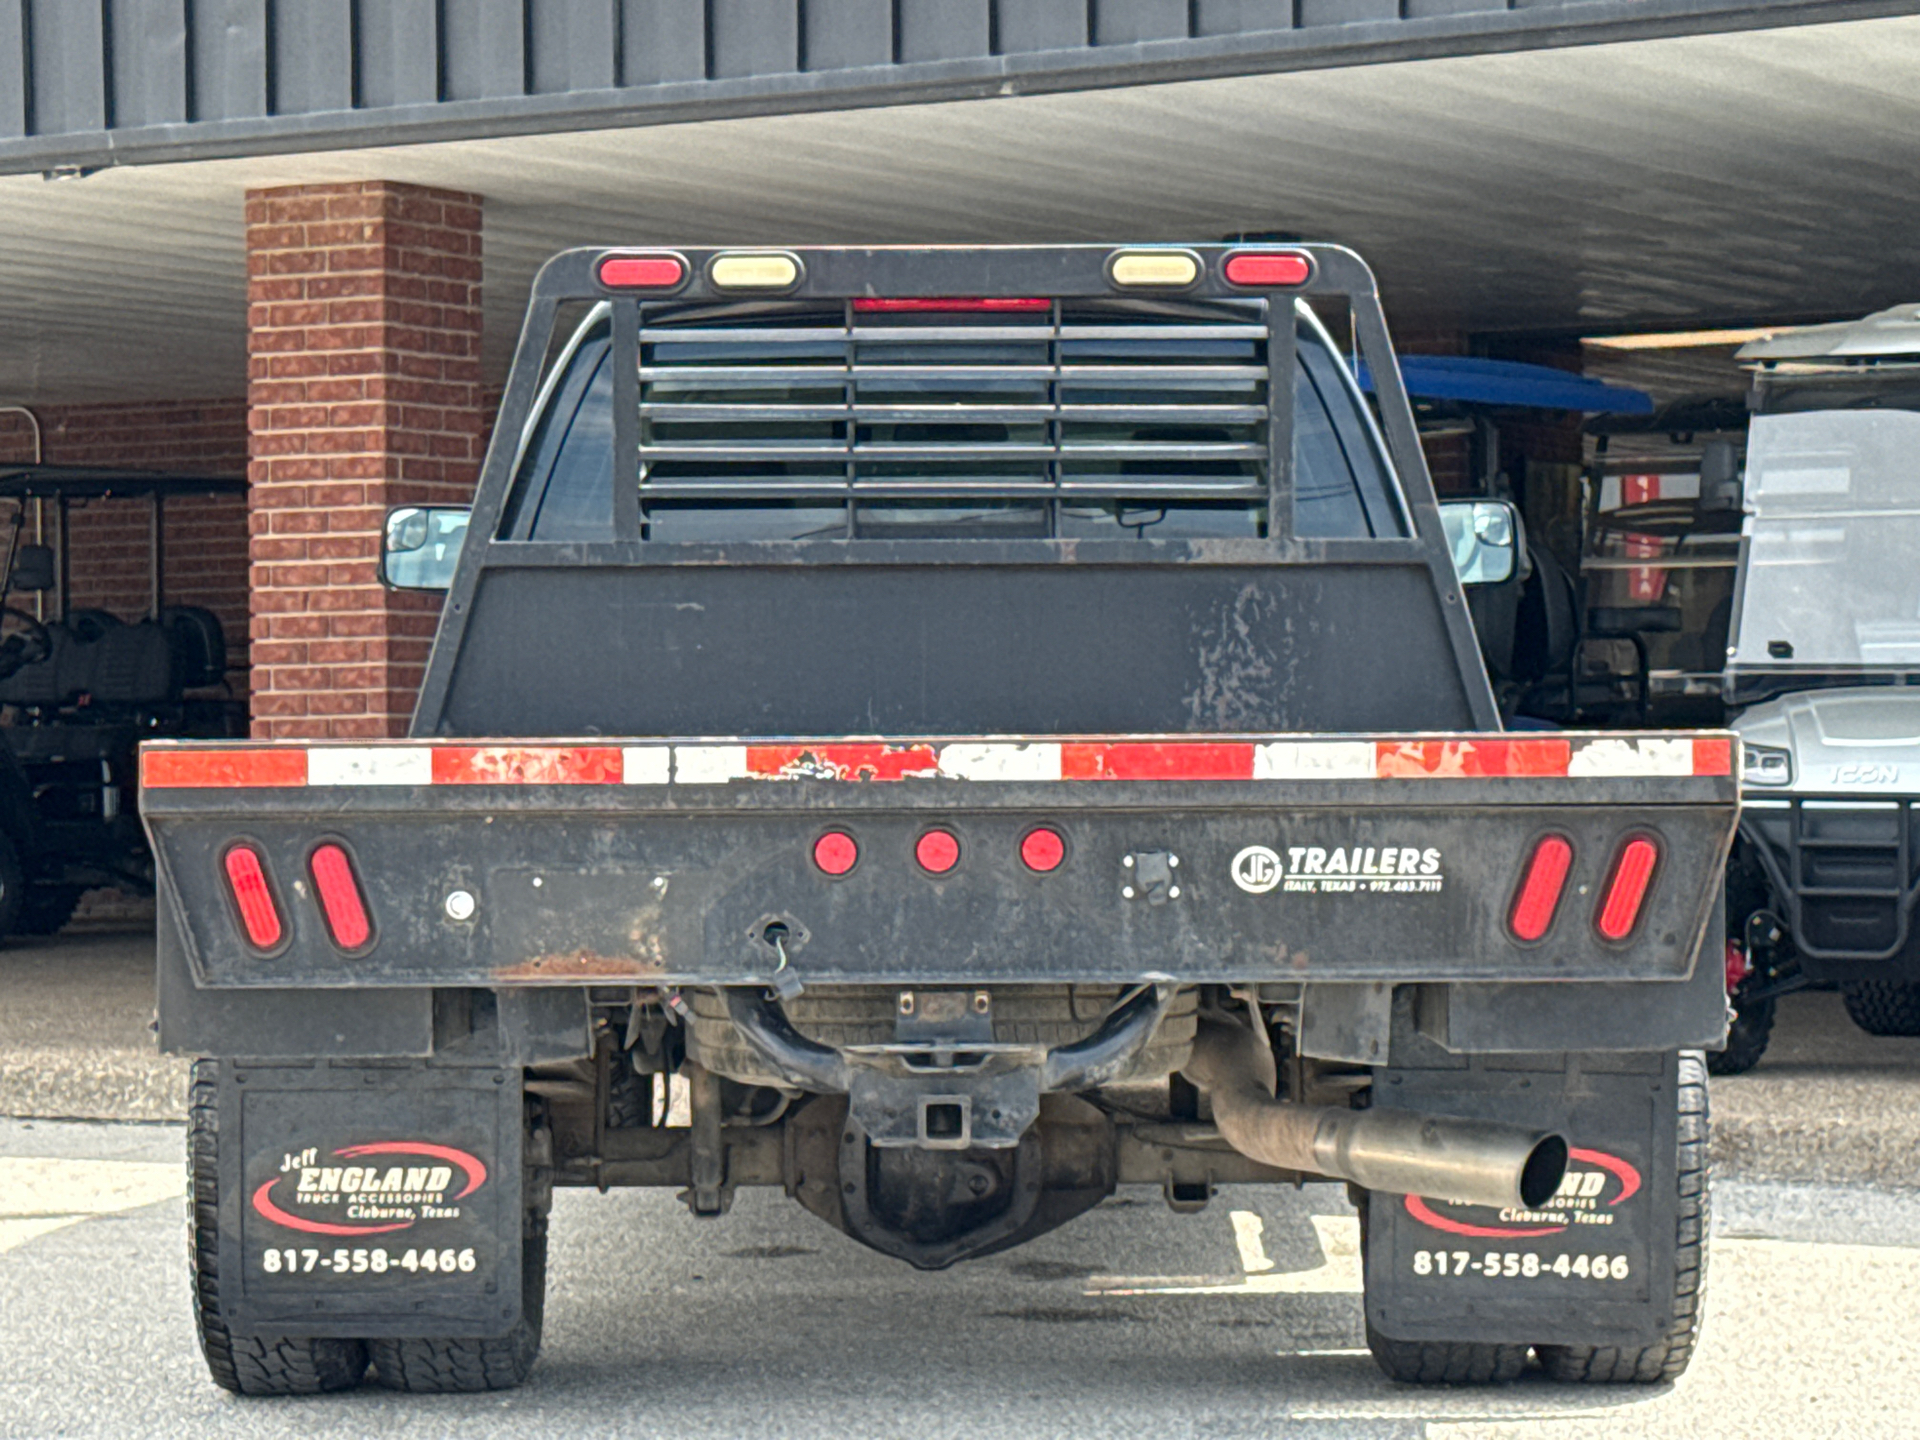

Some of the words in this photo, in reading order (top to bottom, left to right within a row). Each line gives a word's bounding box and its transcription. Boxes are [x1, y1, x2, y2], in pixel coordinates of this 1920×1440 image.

[1830, 765, 1900, 784] ICON
[1287, 846, 1442, 874] TRAILERS
[1320, 880, 1356, 892] TEXAS
[280, 1146, 318, 1173] Jeff
[296, 1166, 453, 1193] ENGLAND
[296, 1193, 340, 1204] TRUCK
[347, 1193, 444, 1204] ACCESSORIES
[346, 1205, 417, 1220] Cleburne,
[421, 1205, 461, 1219] Texas
[1498, 1207, 1570, 1225] Cleburne,
[1573, 1210, 1614, 1225] Texas
[262, 1247, 477, 1274] 817-558-4466
[1413, 1250, 1630, 1280] 817-558-4466
